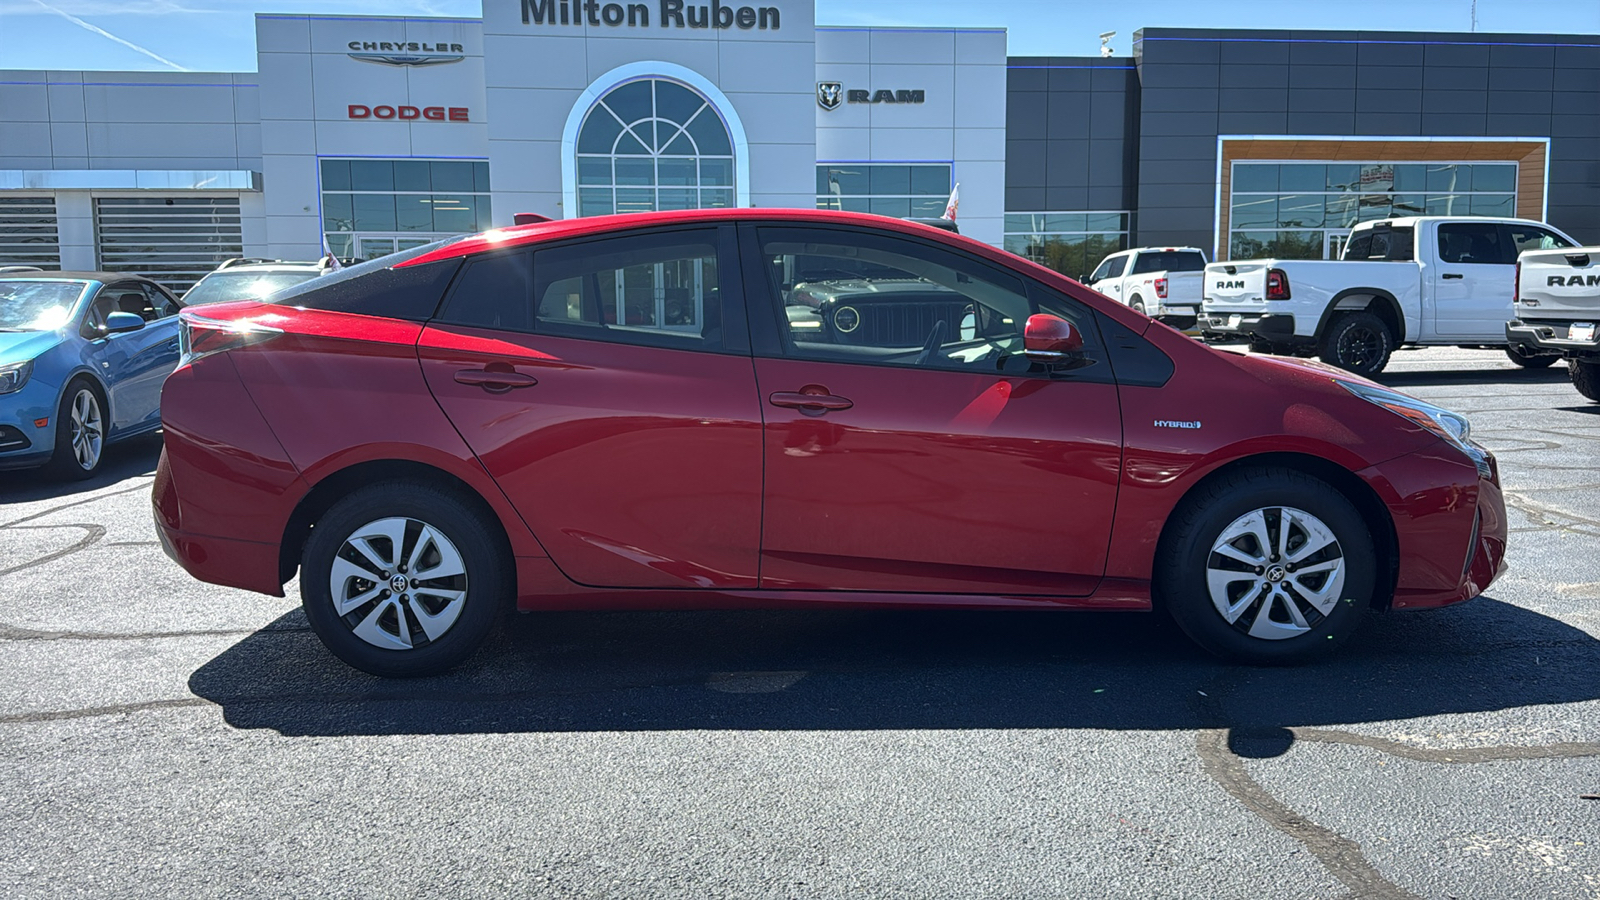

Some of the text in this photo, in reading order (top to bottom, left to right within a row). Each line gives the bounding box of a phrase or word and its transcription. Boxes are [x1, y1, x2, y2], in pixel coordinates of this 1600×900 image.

[521, 0, 780, 30] Milton Ruben
[348, 41, 464, 53] CHRYSLER
[847, 89, 925, 104] RAM
[348, 104, 469, 121] DODGE
[1216, 280, 1245, 289] RAM
[1547, 275, 1600, 287] RAM
[1153, 420, 1194, 429] HYBRID
